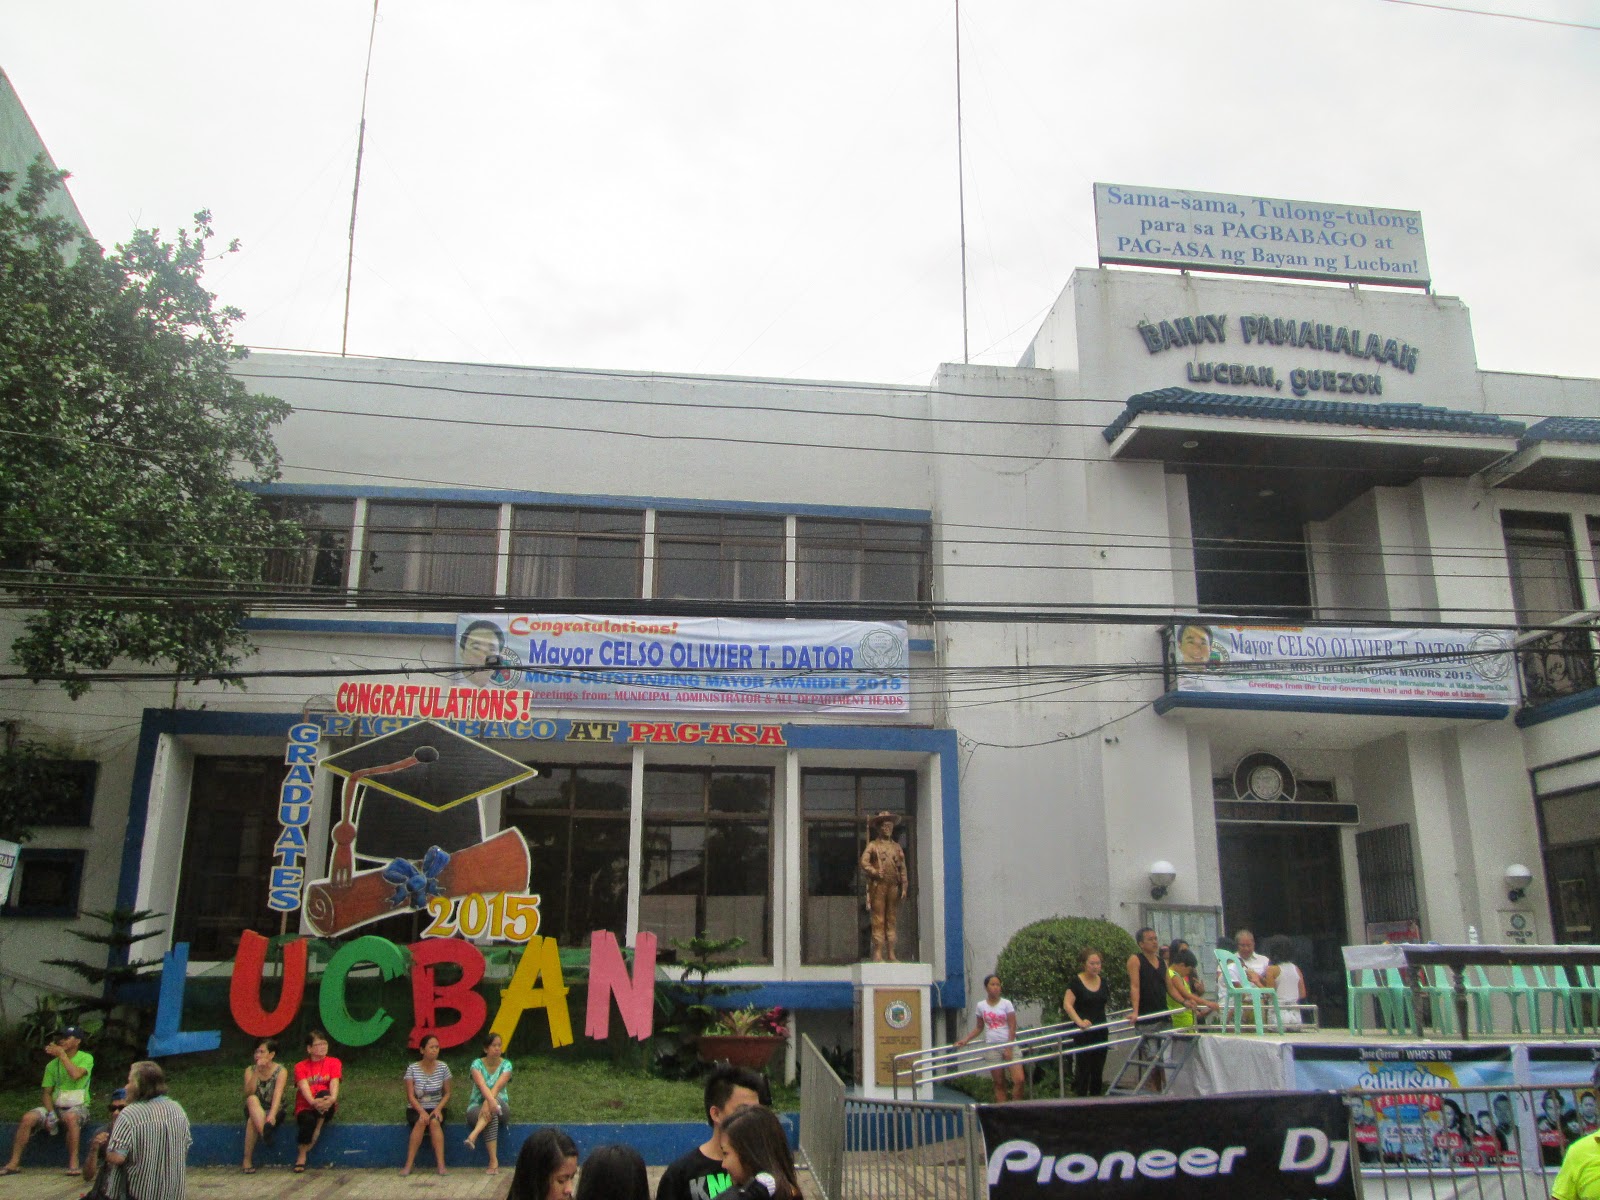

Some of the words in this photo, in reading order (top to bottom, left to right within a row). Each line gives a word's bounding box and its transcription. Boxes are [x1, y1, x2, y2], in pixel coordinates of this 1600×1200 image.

[1107, 185, 1245, 218] Sama-sama,
[1252, 199, 1418, 234] Tulong-tulong
[1140, 217, 1186, 235] para
[1194, 223, 1214, 236] sa
[1222, 221, 1368, 249] PAGBABAGO
[1374, 236, 1394, 250] at
[1117, 236, 1215, 259] PAG-ASA
[1220, 249, 1246, 265] ng
[1252, 248, 1307, 268] Bayan
[1314, 256, 1338, 272] ng
[1344, 255, 1418, 274] Lucban!
[1138, 314, 1228, 353] BAHAY
[1240, 315, 1419, 374] PAMAHALAAN
[1290, 367, 1383, 396] QUEZON
[509, 616, 679, 637] Congratulations!
[528, 639, 593, 667] Mayor
[599, 640, 664, 667] CELSO
[669, 642, 753, 668] OLIVIER
[758, 645, 776, 668] T.
[782, 645, 854, 669] DATOR
[1230, 633, 1274, 656] Mayor
[1277, 634, 1327, 658] CELSO
[1331, 637, 1393, 659] OLIVIER
[1415, 641, 1467, 664] DATOR
[525, 670, 573, 683] MOST
[580, 671, 700, 687] OUTSTANDING
[705, 676, 764, 688] MAYOR
[770, 677, 850, 690] AWARDEE
[856, 678, 902, 690] 2015
[1248, 680, 1283, 690] Greetings
[1285, 682, 1302, 690] from
[1339, 684, 1381, 693] Government
[1427, 689, 1452, 697] People
[1400, 668, 1441, 678] MAYORS
[1445, 670, 1473, 680] 2015
[336, 682, 531, 722] CONGRATULATIONS!
[532, 690, 579, 702] reetings
[582, 690, 611, 701] from:
[614, 690, 670, 702] MUNICIPAL
[675, 692, 761, 704] ADMINISTRATOR
[765, 694, 772, 704] &
[775, 694, 794, 704] ALL
[797, 695, 866, 705] DEPARTMENT
[869, 695, 904, 706] HEADS
[565, 720, 619, 743] AT
[628, 722, 787, 747] PAG-ASA
[268, 723, 321, 912] GRADUATES
[421, 891, 541, 941] 2015
[147, 928, 657, 1057] LUCBAN
[1406, 1049, 1437, 1060] WHO'S
[988, 1139, 1246, 1185] Pioneer
